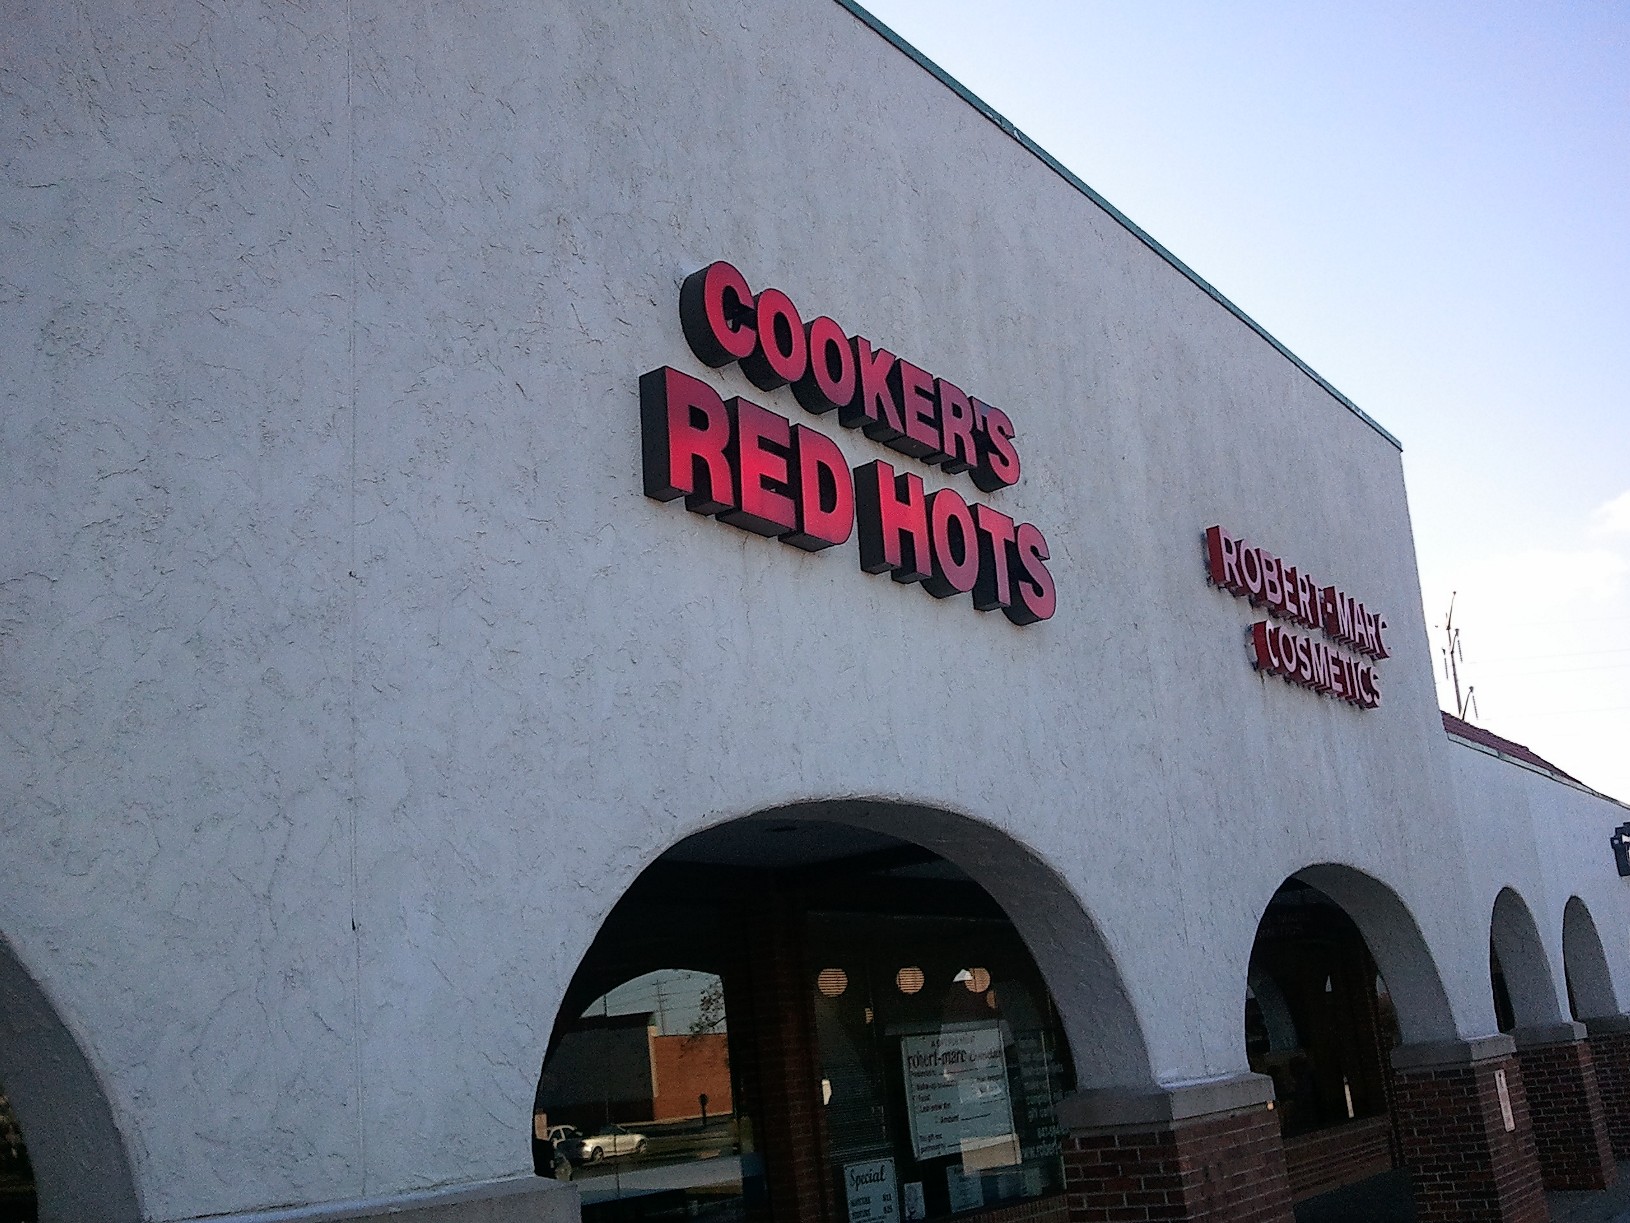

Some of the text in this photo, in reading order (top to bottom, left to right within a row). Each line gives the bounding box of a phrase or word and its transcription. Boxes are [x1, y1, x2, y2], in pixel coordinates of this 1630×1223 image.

[681, 260, 1021, 491] COOKER'S
[642, 366, 1057, 625] RED HOTS
[1255, 619, 1382, 708] COSMETICS
[850, 1164, 886, 1191] Special
